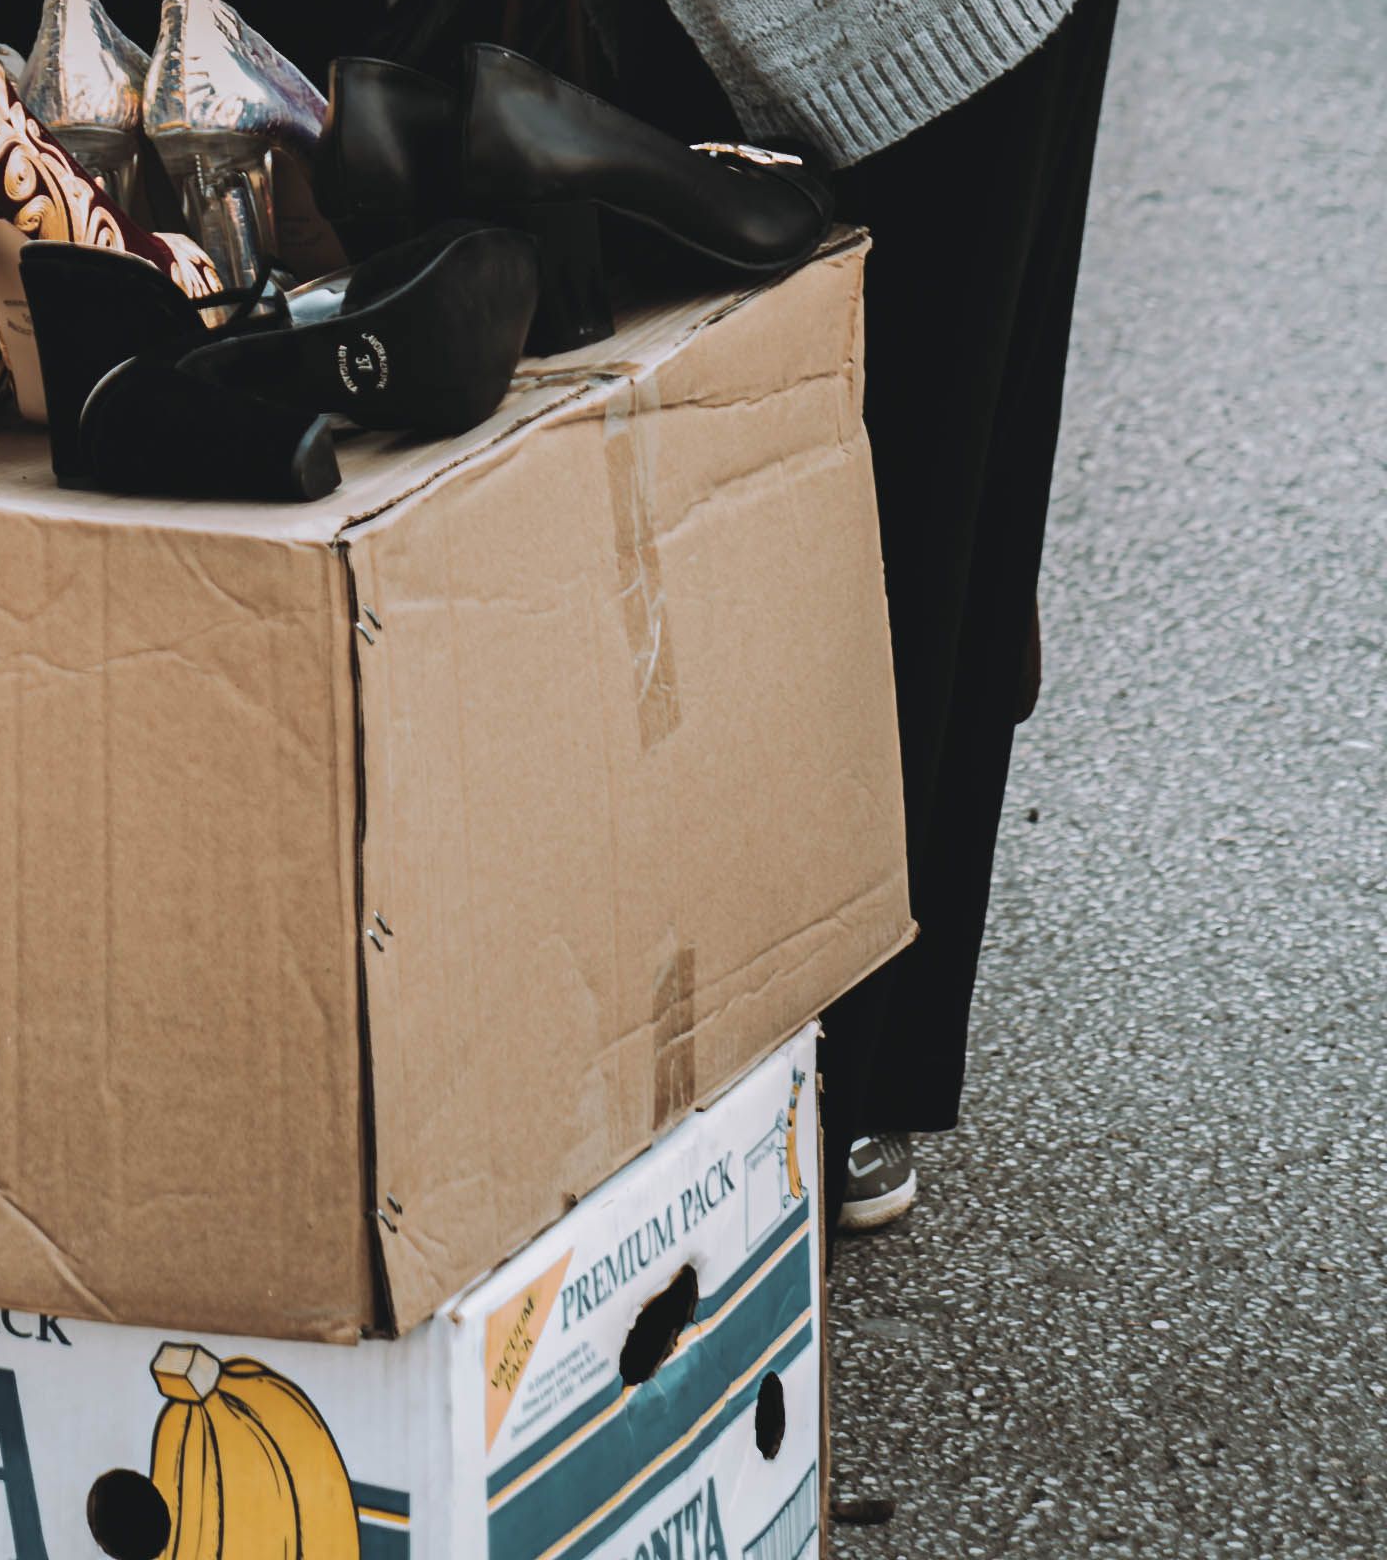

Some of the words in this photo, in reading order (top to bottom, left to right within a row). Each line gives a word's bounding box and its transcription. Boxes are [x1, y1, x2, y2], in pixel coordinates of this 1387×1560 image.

[355, 354, 374, 370] 37
[560, 1204, 676, 1333] PREMIUM
[680, 1151, 736, 1234] PACK
[490, 1294, 535, 1390] VACUUM
[505, 1337, 534, 1393] PACK
